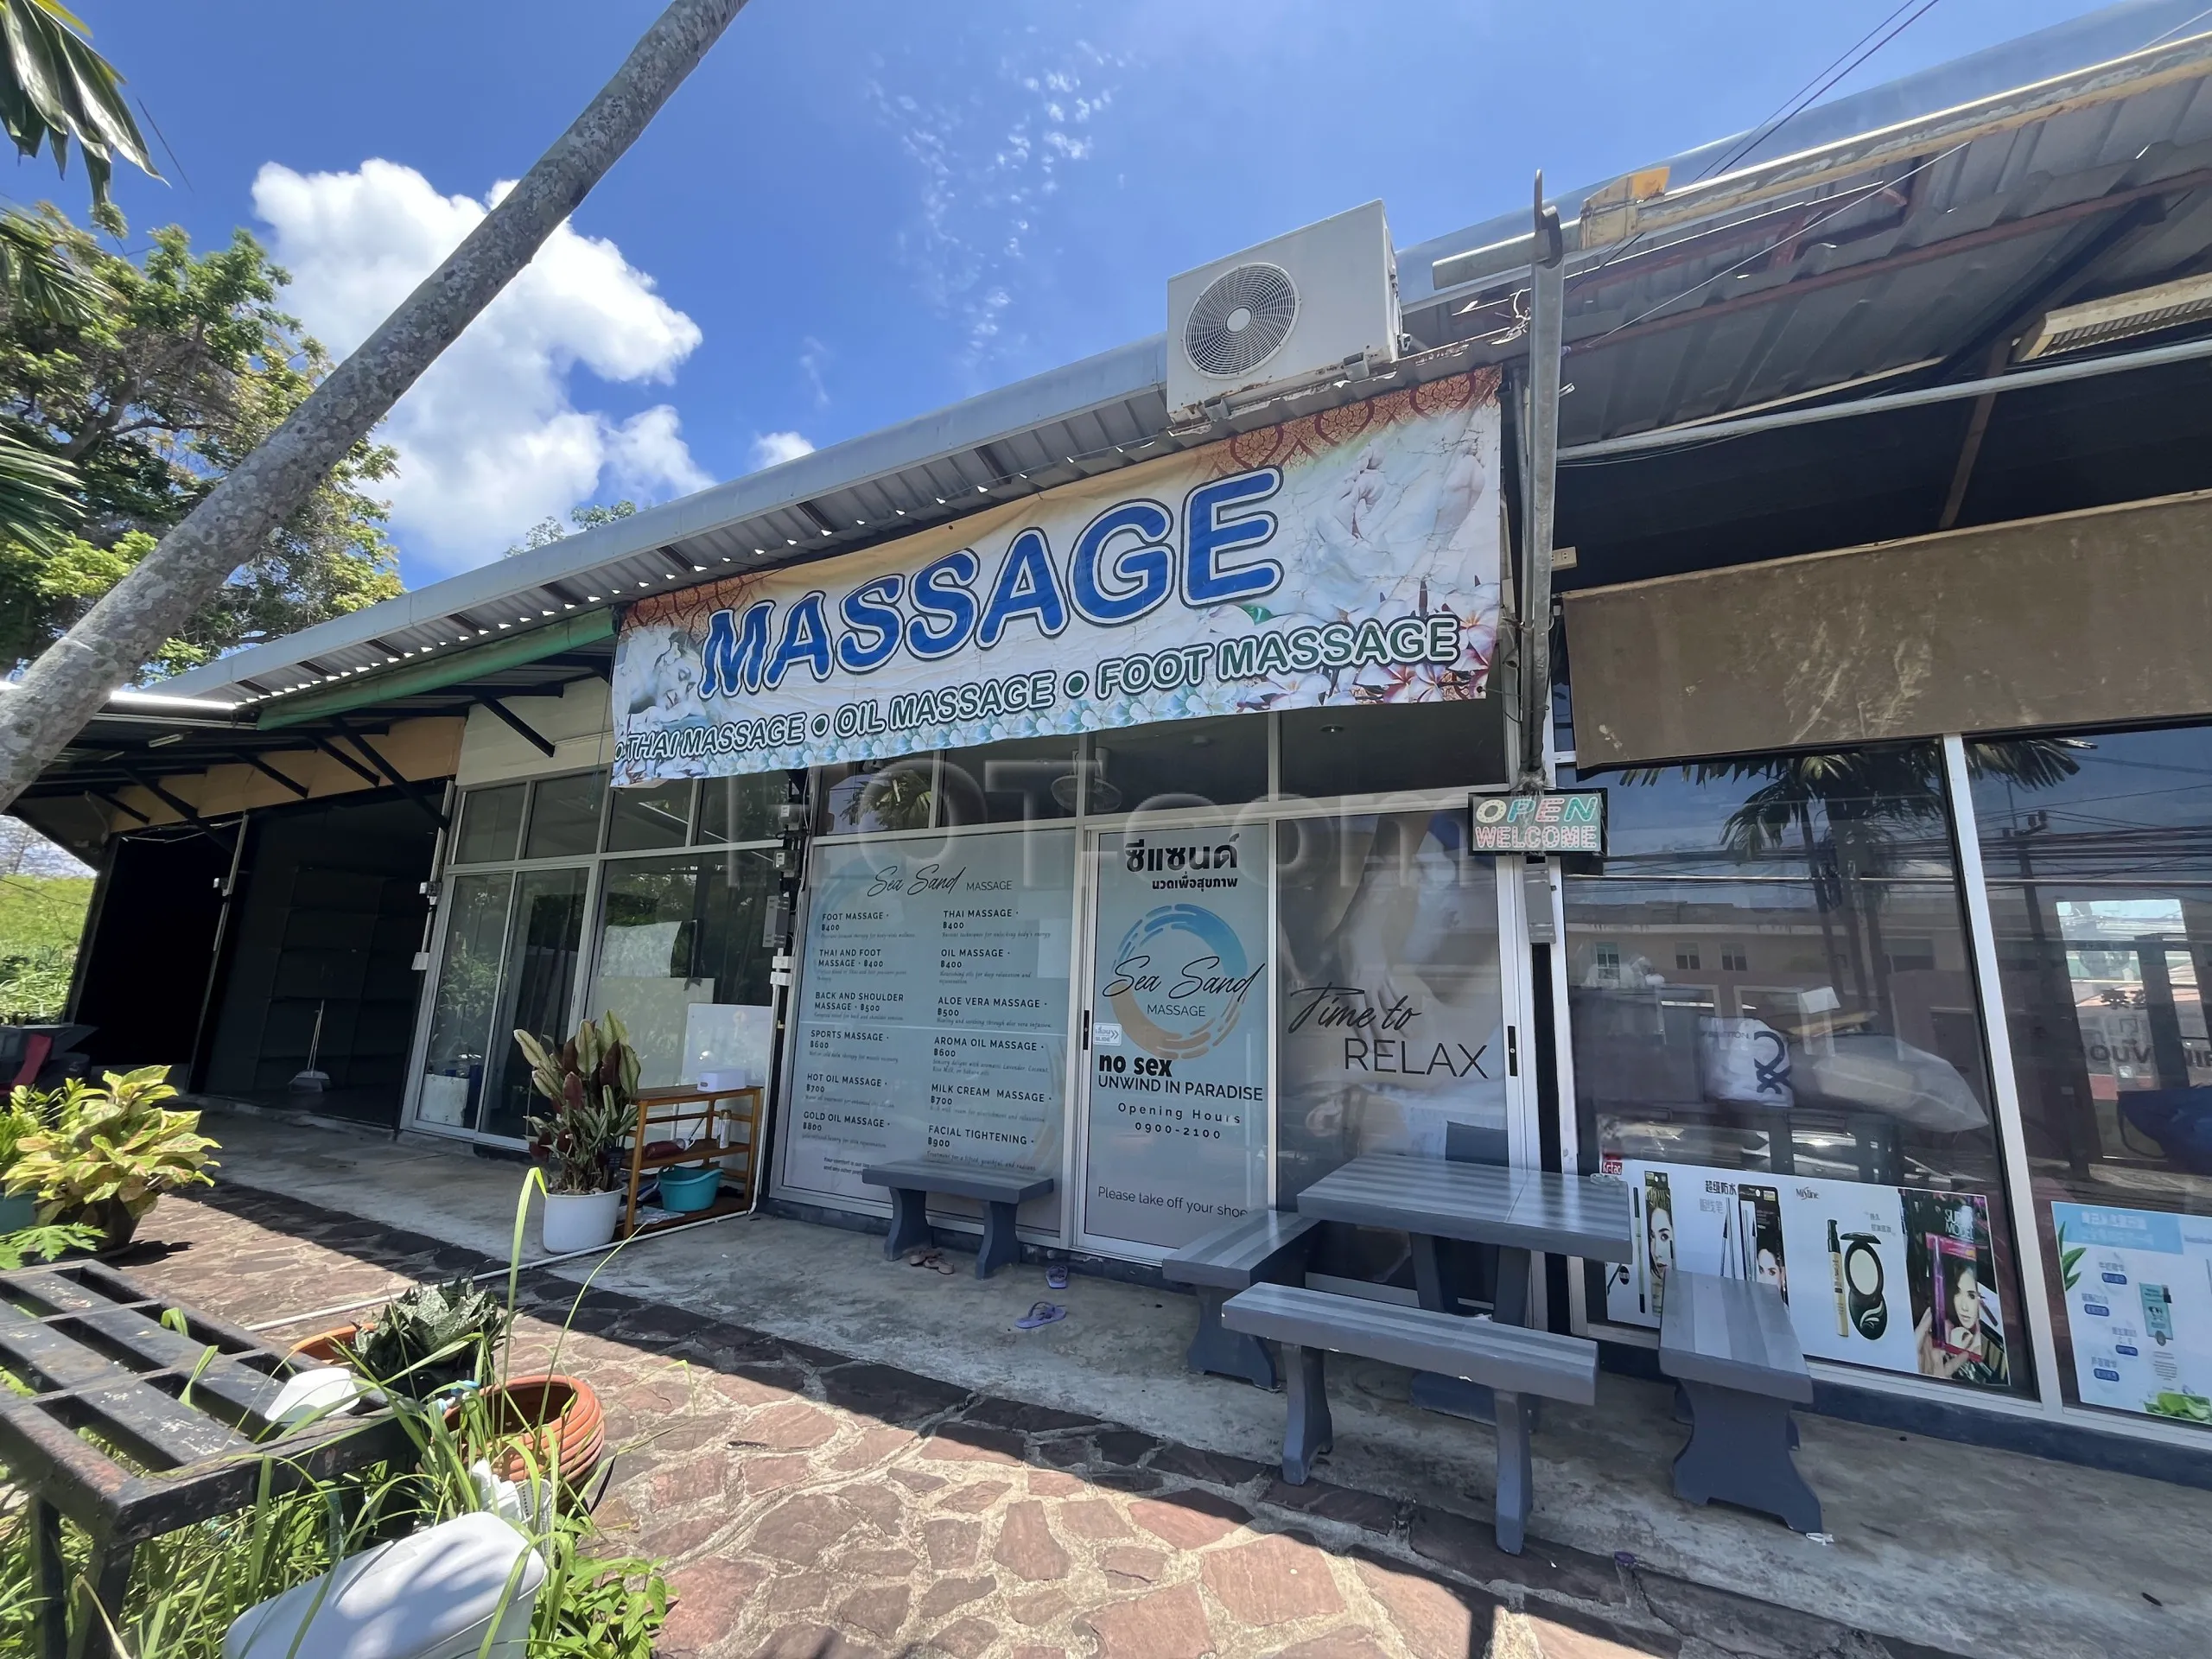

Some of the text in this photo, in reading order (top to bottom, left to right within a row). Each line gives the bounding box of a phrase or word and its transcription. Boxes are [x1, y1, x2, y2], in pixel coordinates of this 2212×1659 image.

[697, 466, 1283, 699] MASSAGE
[626, 613, 1464, 762] THAI MASSAGE OIL MASSAGE FOOT MASSAGE
[1476, 797, 1599, 823] OPEN
[1475, 825, 1598, 849] WELCOME
[1125, 833, 1240, 872] ซีแซนด์
[867, 864, 1013, 897] Sea Sand MASSAGE
[1152, 871, 1238, 892] นวดเพื่อสุขภาพ
[845, 912, 884, 920] MASSAGE
[944, 909, 1013, 918] THAI MASSAGE
[941, 949, 1004, 957] OIL MASSAGE
[1102, 955, 1266, 1002] Sea Sand
[814, 1002, 851, 1011] MASSAGE
[815, 991, 904, 1002] BACK AND SHOULDER
[938, 996, 1040, 1008] ALOE VERA MASSAGE
[1147, 1004, 1206, 1017] MASSAGE
[1287, 982, 1422, 1034] Time to
[810, 1029, 883, 1041] SPORTS MASSAGE
[934, 1037, 1037, 1051] AROMA OIL MASSAGE
[1099, 1054, 1173, 1077] no sex
[1344, 1037, 1489, 1079] RELAX
[807, 1073, 881, 1087] HOT OIL MASSAGE
[1098, 1076, 1263, 1102] UNWIND IN PARADISE
[931, 1084, 1045, 1103] MILK CREAM MASSAGE
[804, 1111, 885, 1128] GOLD OIL MASSAGE
[1117, 1103, 1241, 1124] Opening Hours
[929, 1125, 1027, 1145] FACIAL TIGHTENING
[1135, 1122, 1221, 1140] 0900-2100
[1098, 1185, 1136, 1204] Please
[1166, 1197, 1184, 1210] off
[1186, 1200, 1213, 1214] your
